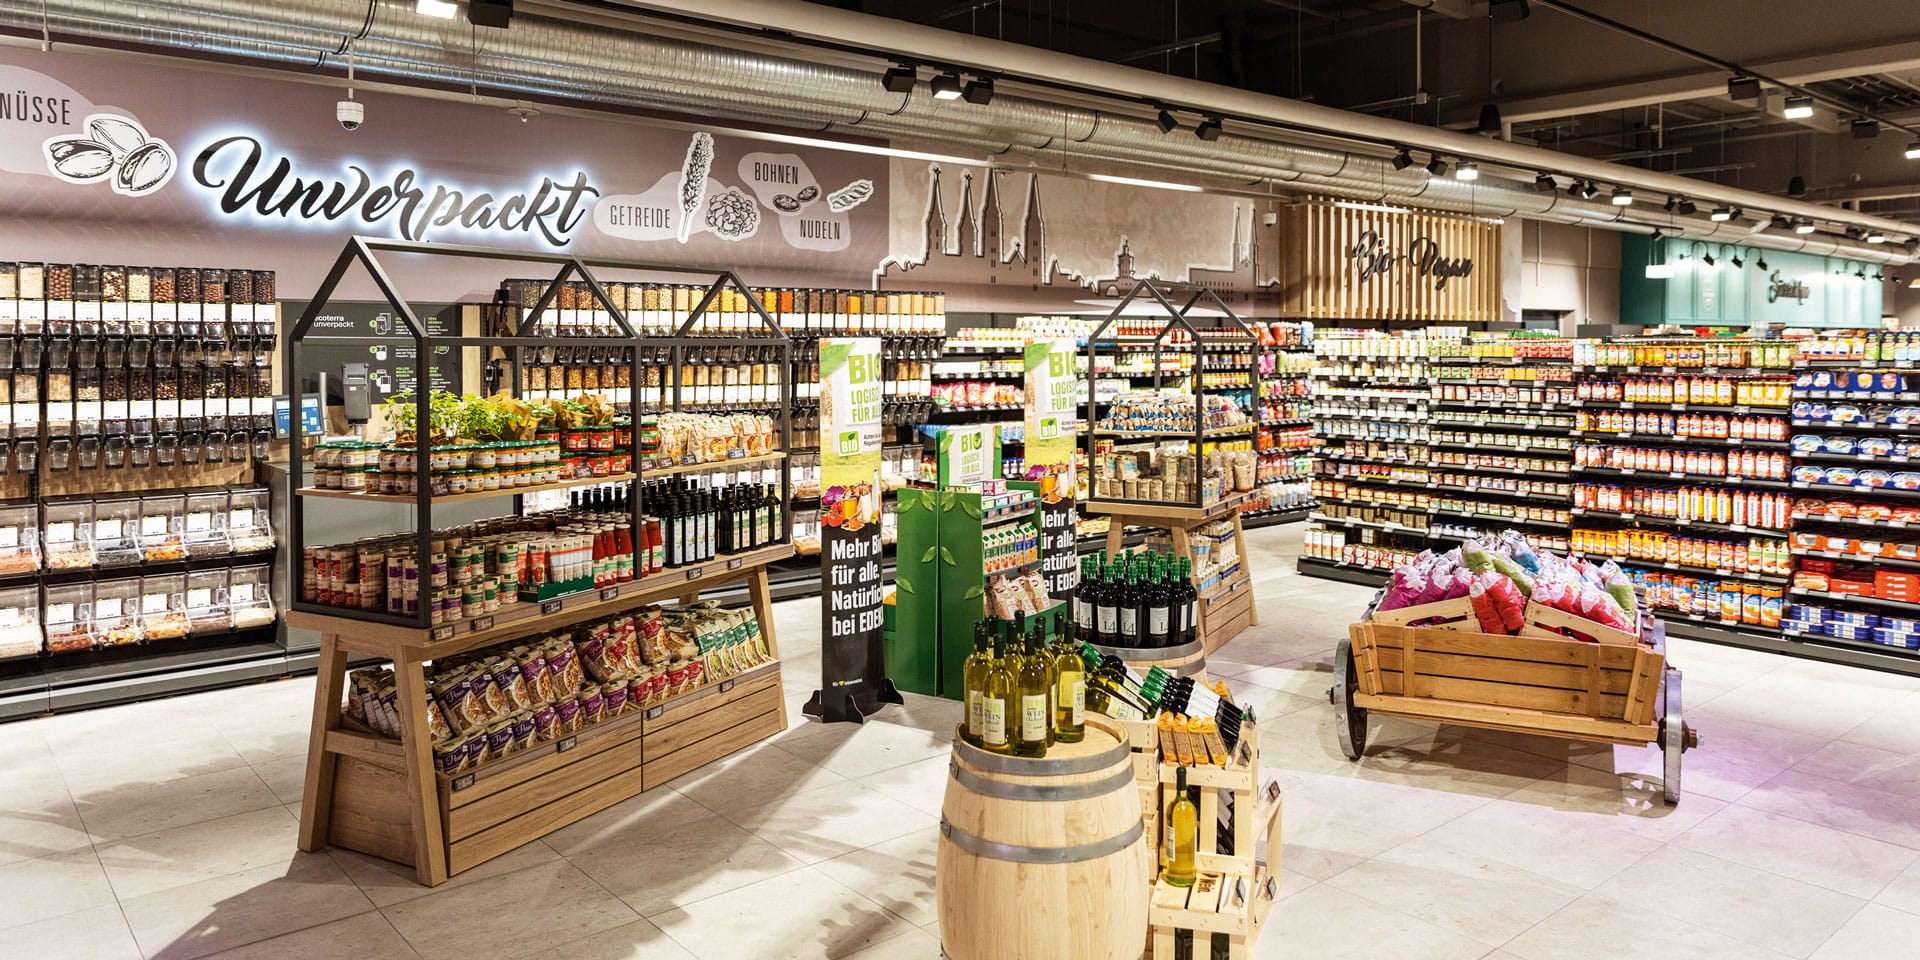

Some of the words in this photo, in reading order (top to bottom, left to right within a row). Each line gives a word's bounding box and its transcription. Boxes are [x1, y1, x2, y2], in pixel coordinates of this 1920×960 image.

[0, 90, 71, 126] NÜSSE
[754, 162, 799, 185] BOHNEN
[192, 136, 600, 247] Unverpackt
[610, 205, 671, 229] GETREIDE
[800, 219, 841, 240] NUDELN
[852, 404, 870, 423] FÜR
[842, 440, 858, 452] BIO
[961, 432, 982, 453] BIO
[831, 538, 869, 560] Mehr
[831, 565, 855, 585] für
[859, 560, 880, 583] alle.
[832, 613, 855, 636] bei
[1104, 620, 1117, 633] 14
[1123, 621, 1136, 635] 14
